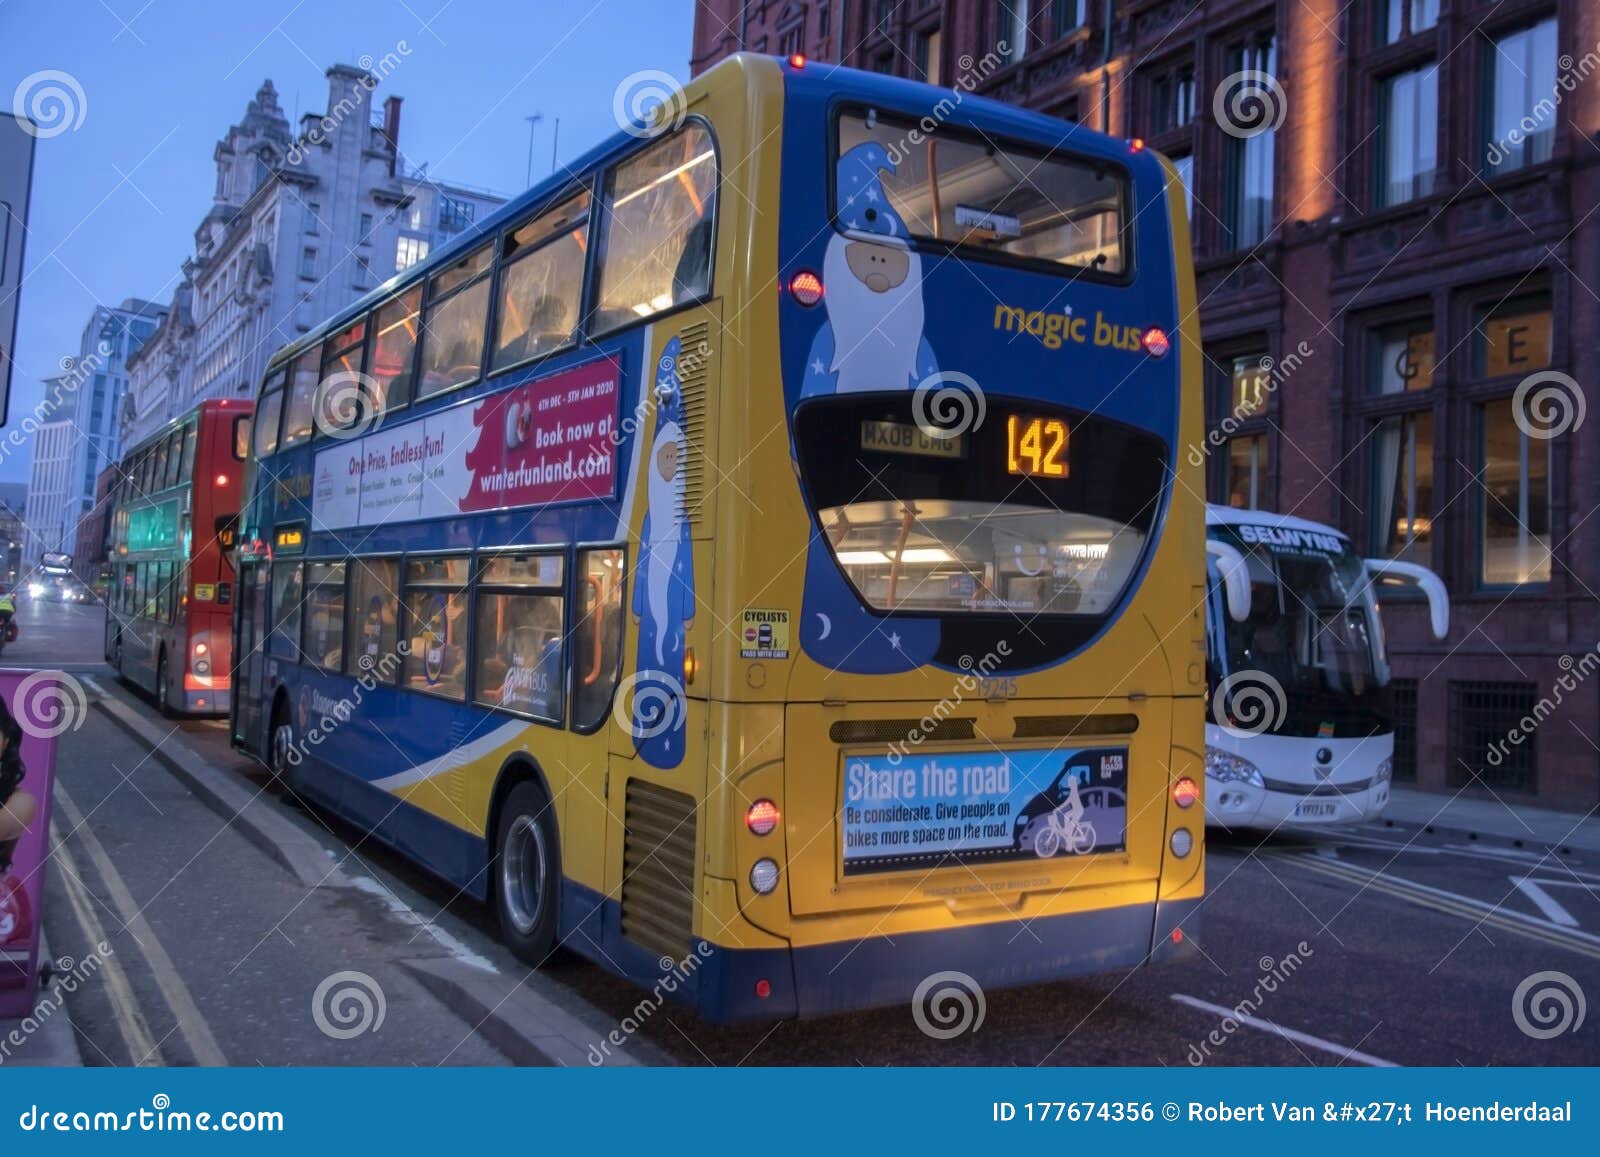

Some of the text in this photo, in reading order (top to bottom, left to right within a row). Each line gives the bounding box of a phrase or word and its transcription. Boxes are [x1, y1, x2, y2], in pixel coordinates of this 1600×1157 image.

[993, 304, 1142, 351] magic bus
[1508, 325, 1529, 365] E
[580, 386, 595, 400] JAN
[596, 380, 614, 395] 2020
[536, 413, 613, 449] Book now at
[1007, 414, 1065, 475] 142
[348, 431, 445, 476] One Price, Endless Fun!
[480, 449, 612, 494] winterfunland.com
[1239, 525, 1343, 553] SELWYNS
[744, 610, 788, 623] CYCLISTS
[848, 757, 1011, 801] Share the road
[847, 799, 1011, 825] Be considerate. Give people on
[847, 822, 1009, 848] bikes more space on the road.
